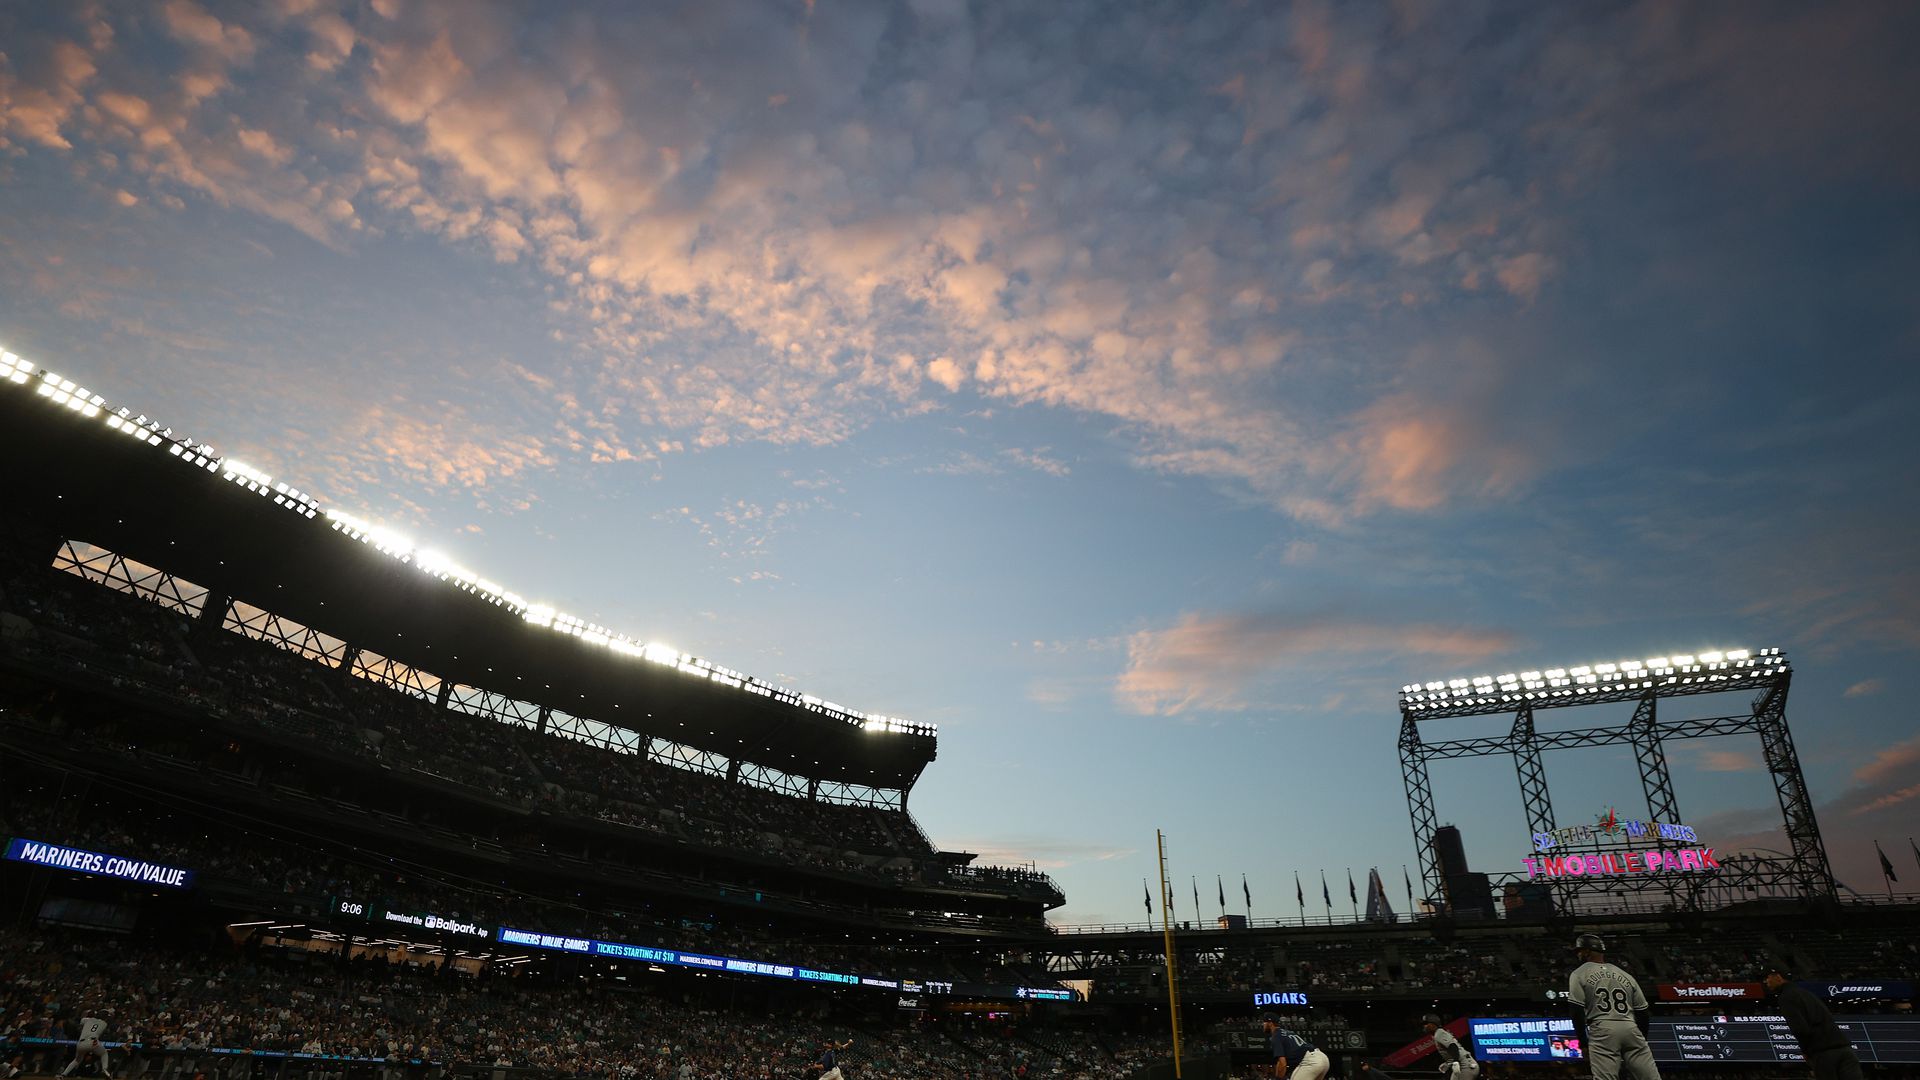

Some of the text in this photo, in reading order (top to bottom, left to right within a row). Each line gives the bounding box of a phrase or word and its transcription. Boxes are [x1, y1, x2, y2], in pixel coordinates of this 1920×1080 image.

[1532, 820, 1697, 851] SEATTLE MARINERS
[20, 842, 186, 886] MARINERS.COM/VALUE
[1522, 848, 1721, 878] T-MOBILE PARK
[341, 902, 362, 915] 9:06
[386, 911, 489, 938] Download the Ballpark App
[503, 930, 590, 952] MARINERS VALUE GAMES
[597, 943, 623, 955] TICKETS
[623, 947, 654, 959] STARTING
[654, 951, 663, 960] AT
[726, 960, 794, 977] MARINERS VALUE GAMES
[799, 969, 819, 980] TICKETS
[819, 971, 842, 982] STARTING
[842, 974, 849, 983] AT
[1587, 971, 1631, 988] BOURGEOIS
[1595, 986, 1629, 1015] 38
[90, 1024, 99, 1033] 8
[1474, 1022, 1520, 1035] MARINERS
[1520, 1021, 1548, 1033] VALUE
